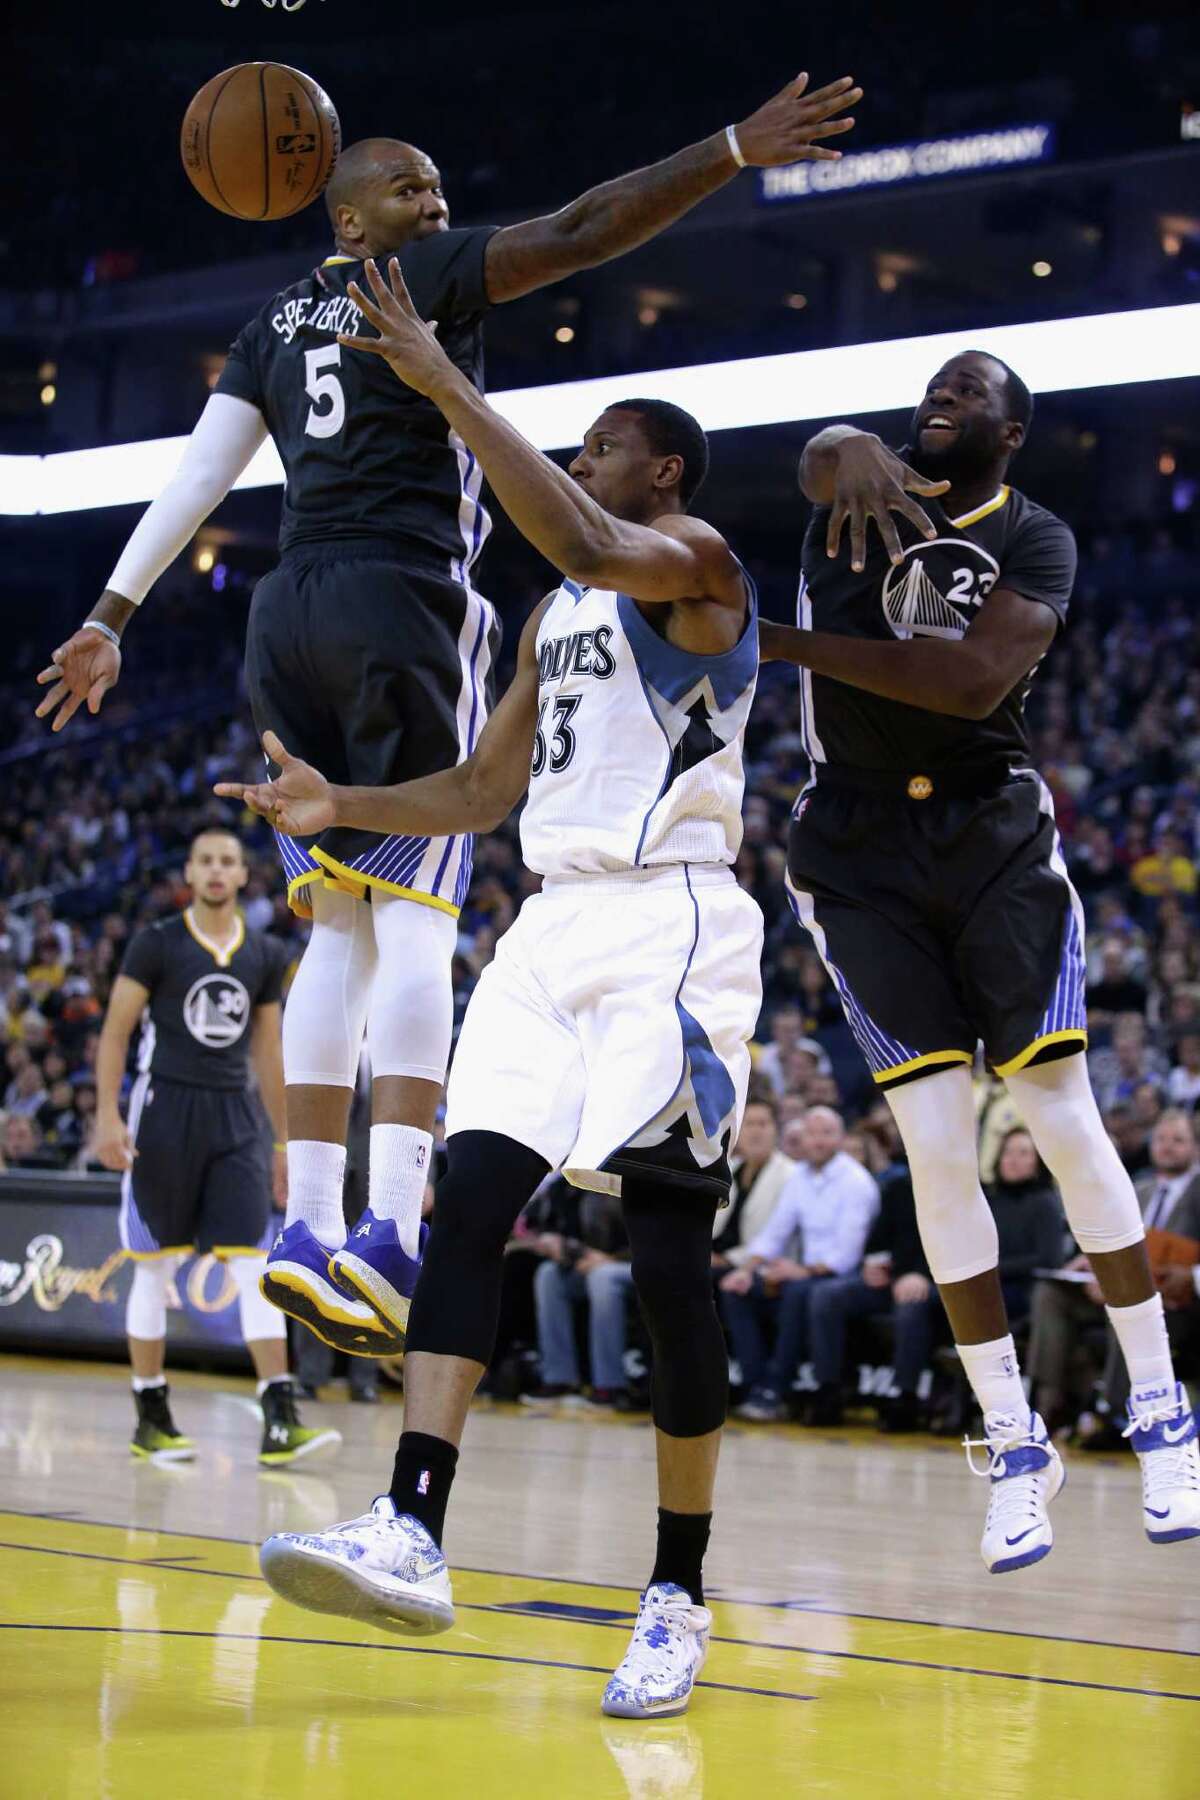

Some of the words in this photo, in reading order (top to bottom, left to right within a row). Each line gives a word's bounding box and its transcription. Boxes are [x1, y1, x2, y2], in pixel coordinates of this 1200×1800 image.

[763, 161, 811, 199] THE
[912, 125, 1049, 176] COMPANY
[272, 296, 364, 344] SPEIGHTS
[304, 342, 346, 439] 5
[946, 567, 996, 607] 23
[539, 624, 617, 688] OLVES
[217, 989, 247, 1016] 30
